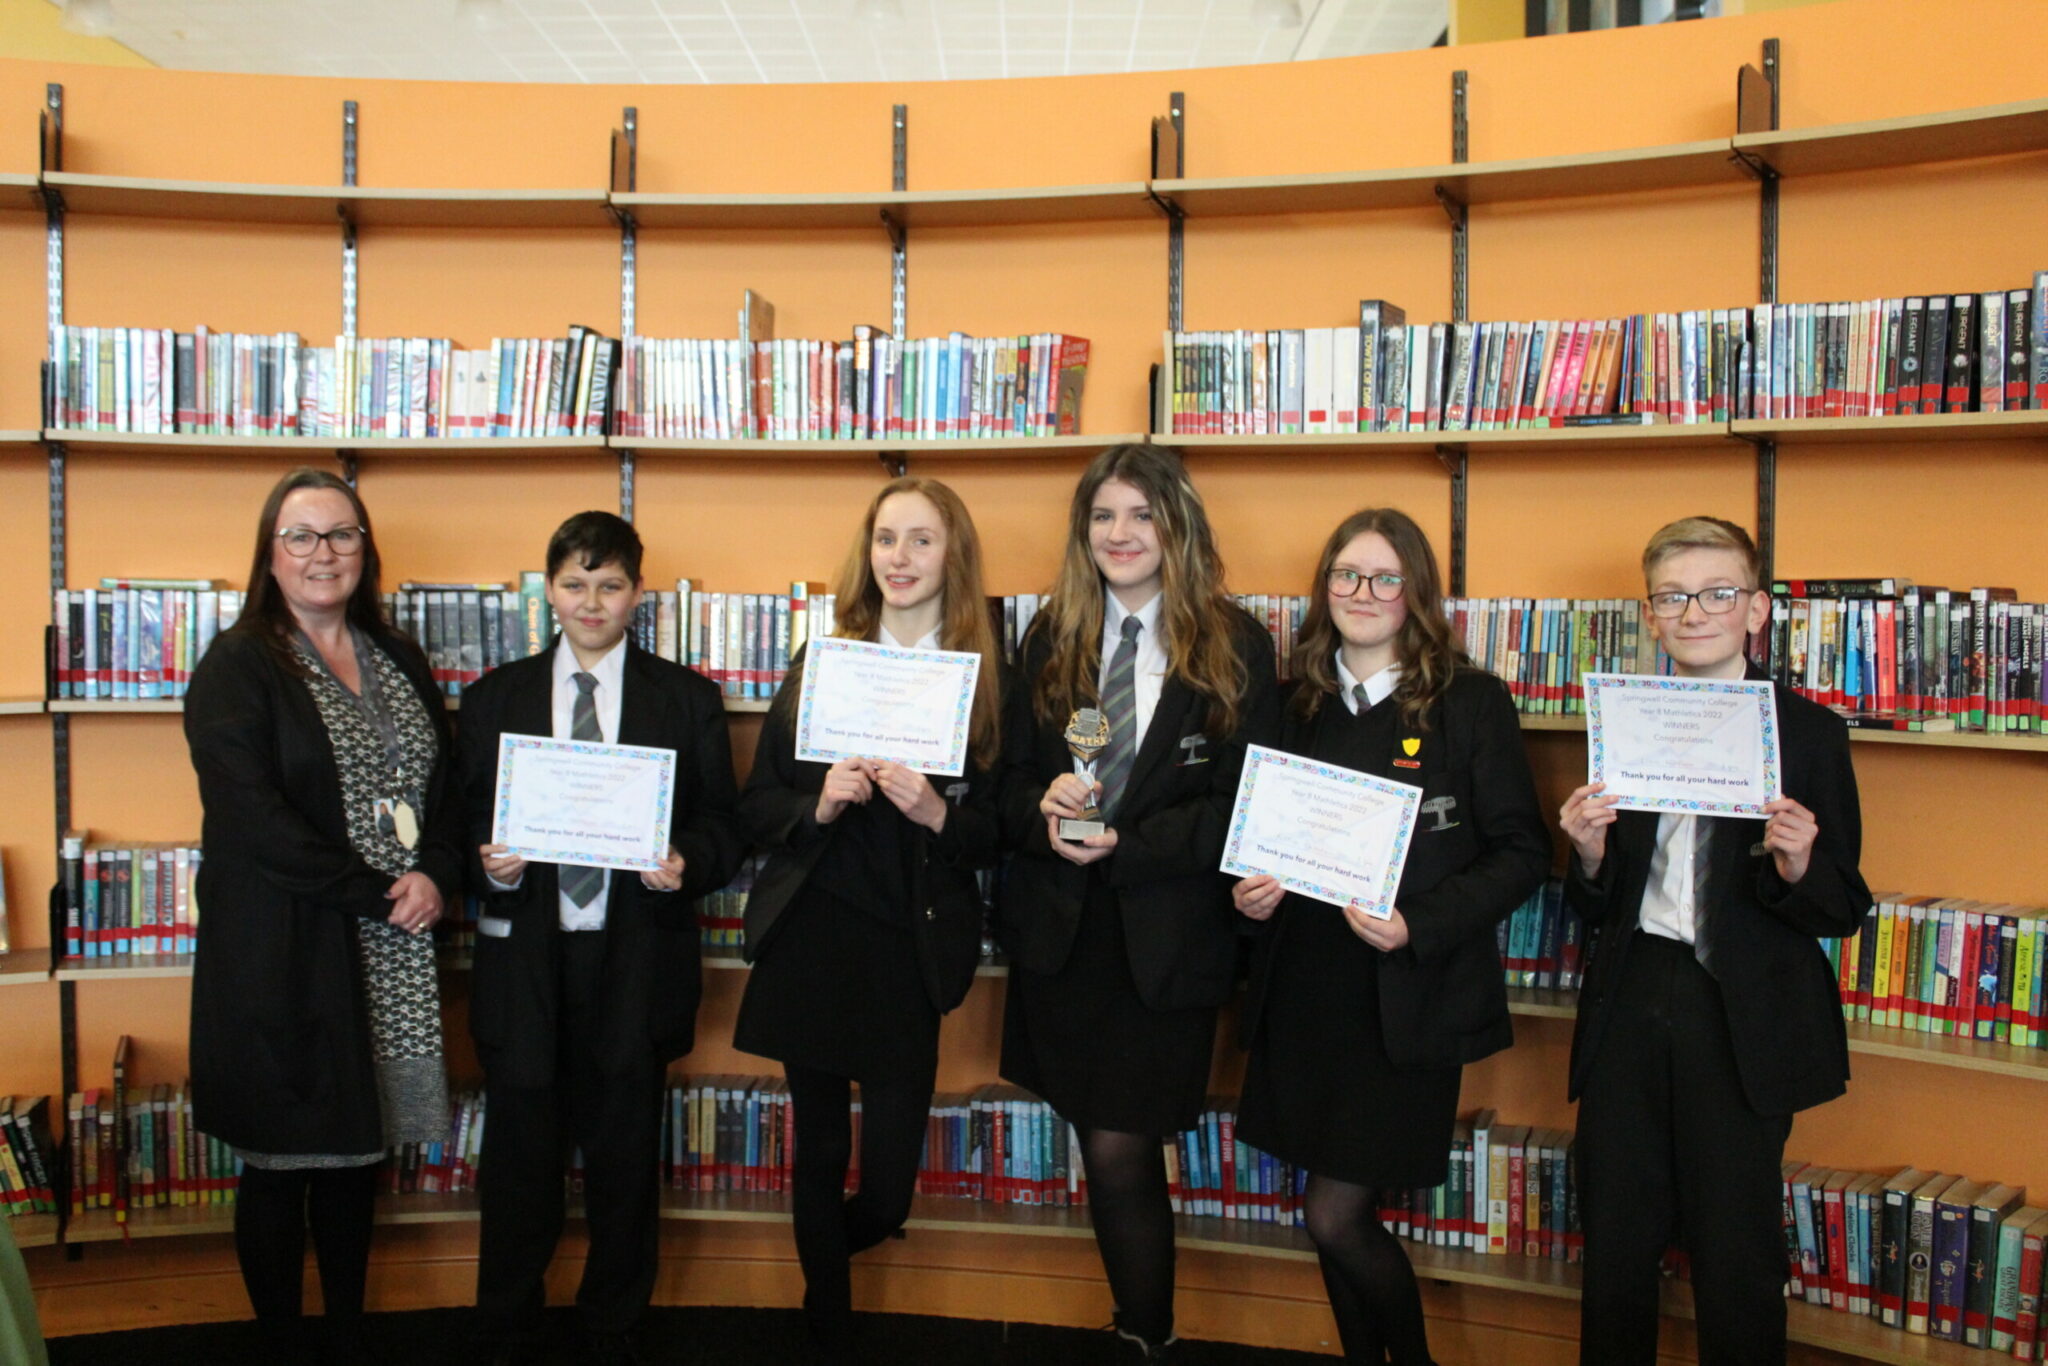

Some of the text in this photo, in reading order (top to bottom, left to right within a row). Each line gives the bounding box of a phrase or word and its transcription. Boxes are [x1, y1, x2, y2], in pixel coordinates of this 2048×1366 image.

[1703, 710, 1723, 719] 2022
[1662, 721, 1701, 730] WINNERS
[1071, 734, 1107, 746] MATHS
[1621, 770, 1644, 779] Thank
[1687, 776, 1706, 785] your
[1707, 776, 1726, 786] hard
[1727, 779, 1750, 787] work
[524, 825, 546, 834] Thank
[604, 833, 621, 842] hard
[1257, 843, 1279, 856] Thank
[1317, 862, 1334, 872] your
[1334, 865, 1352, 877] hard
[1352, 872, 1371, 883] work
